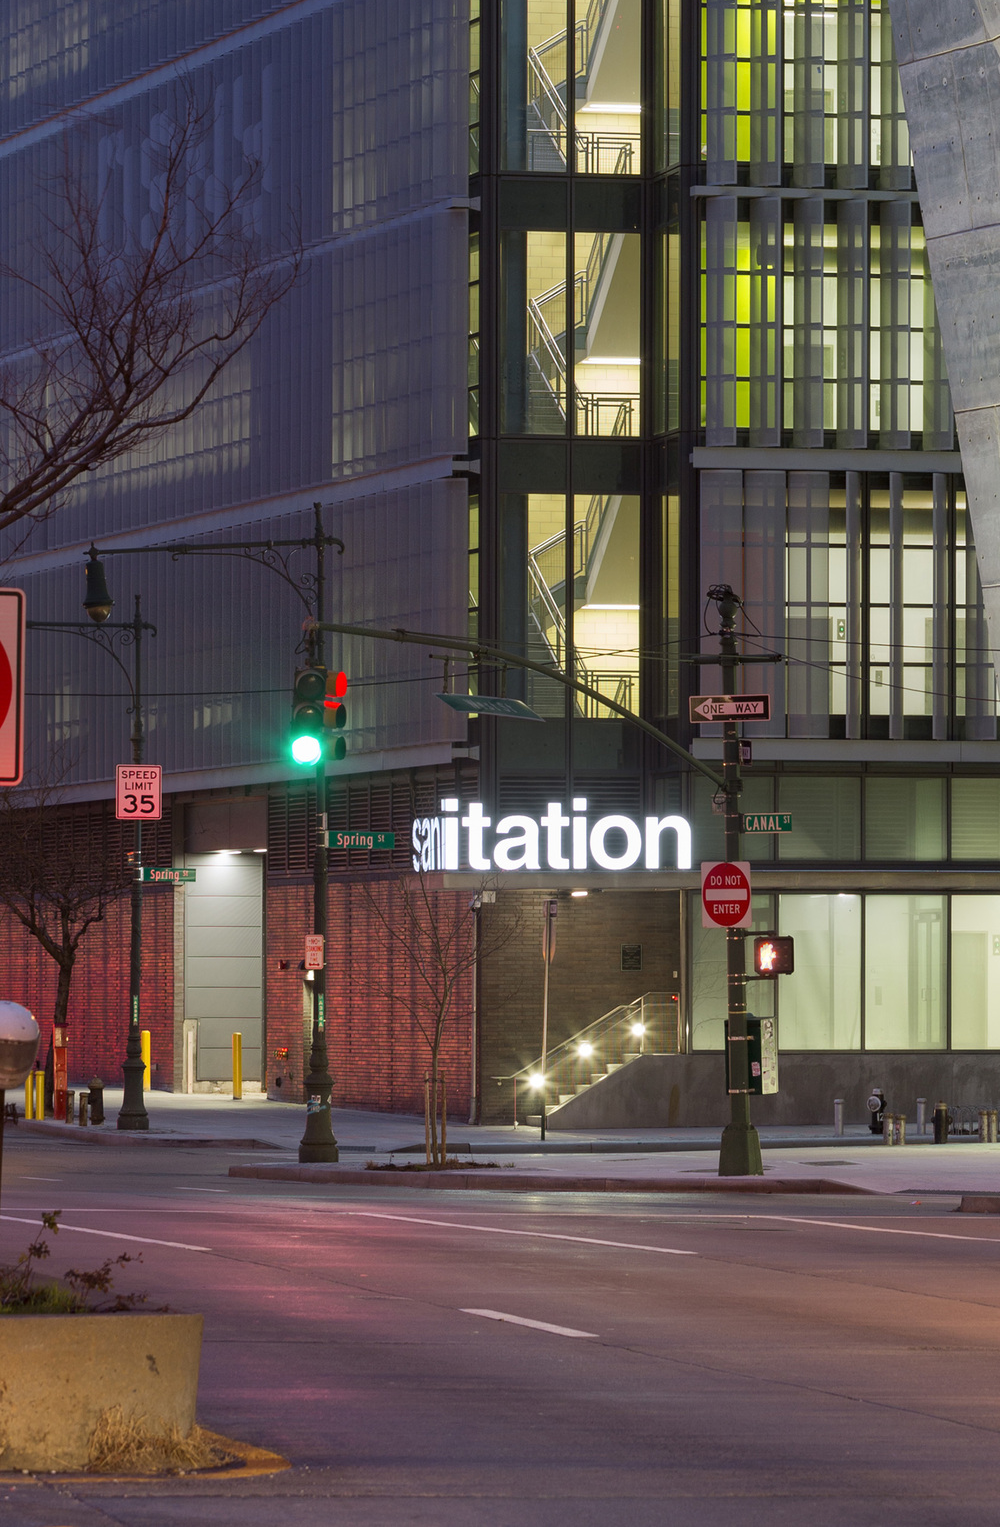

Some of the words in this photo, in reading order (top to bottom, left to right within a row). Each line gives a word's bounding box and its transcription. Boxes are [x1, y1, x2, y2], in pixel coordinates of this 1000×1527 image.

[702, 704, 725, 714] ONE
[735, 703, 759, 714] WAY
[121, 770, 157, 779] SPEED
[125, 782, 153, 790] LIMIT
[123, 794, 155, 813] 35
[745, 816, 782, 831] CANAL
[783, 815, 790, 823] ST
[337, 833, 373, 849] Spring
[377, 834, 384, 842] St
[412, 797, 692, 873] sanitation
[150, 869, 179, 882] Spring
[711, 875, 722, 886] DO
[724, 875, 741, 886] NOT
[713, 904, 740, 914] ENTER
